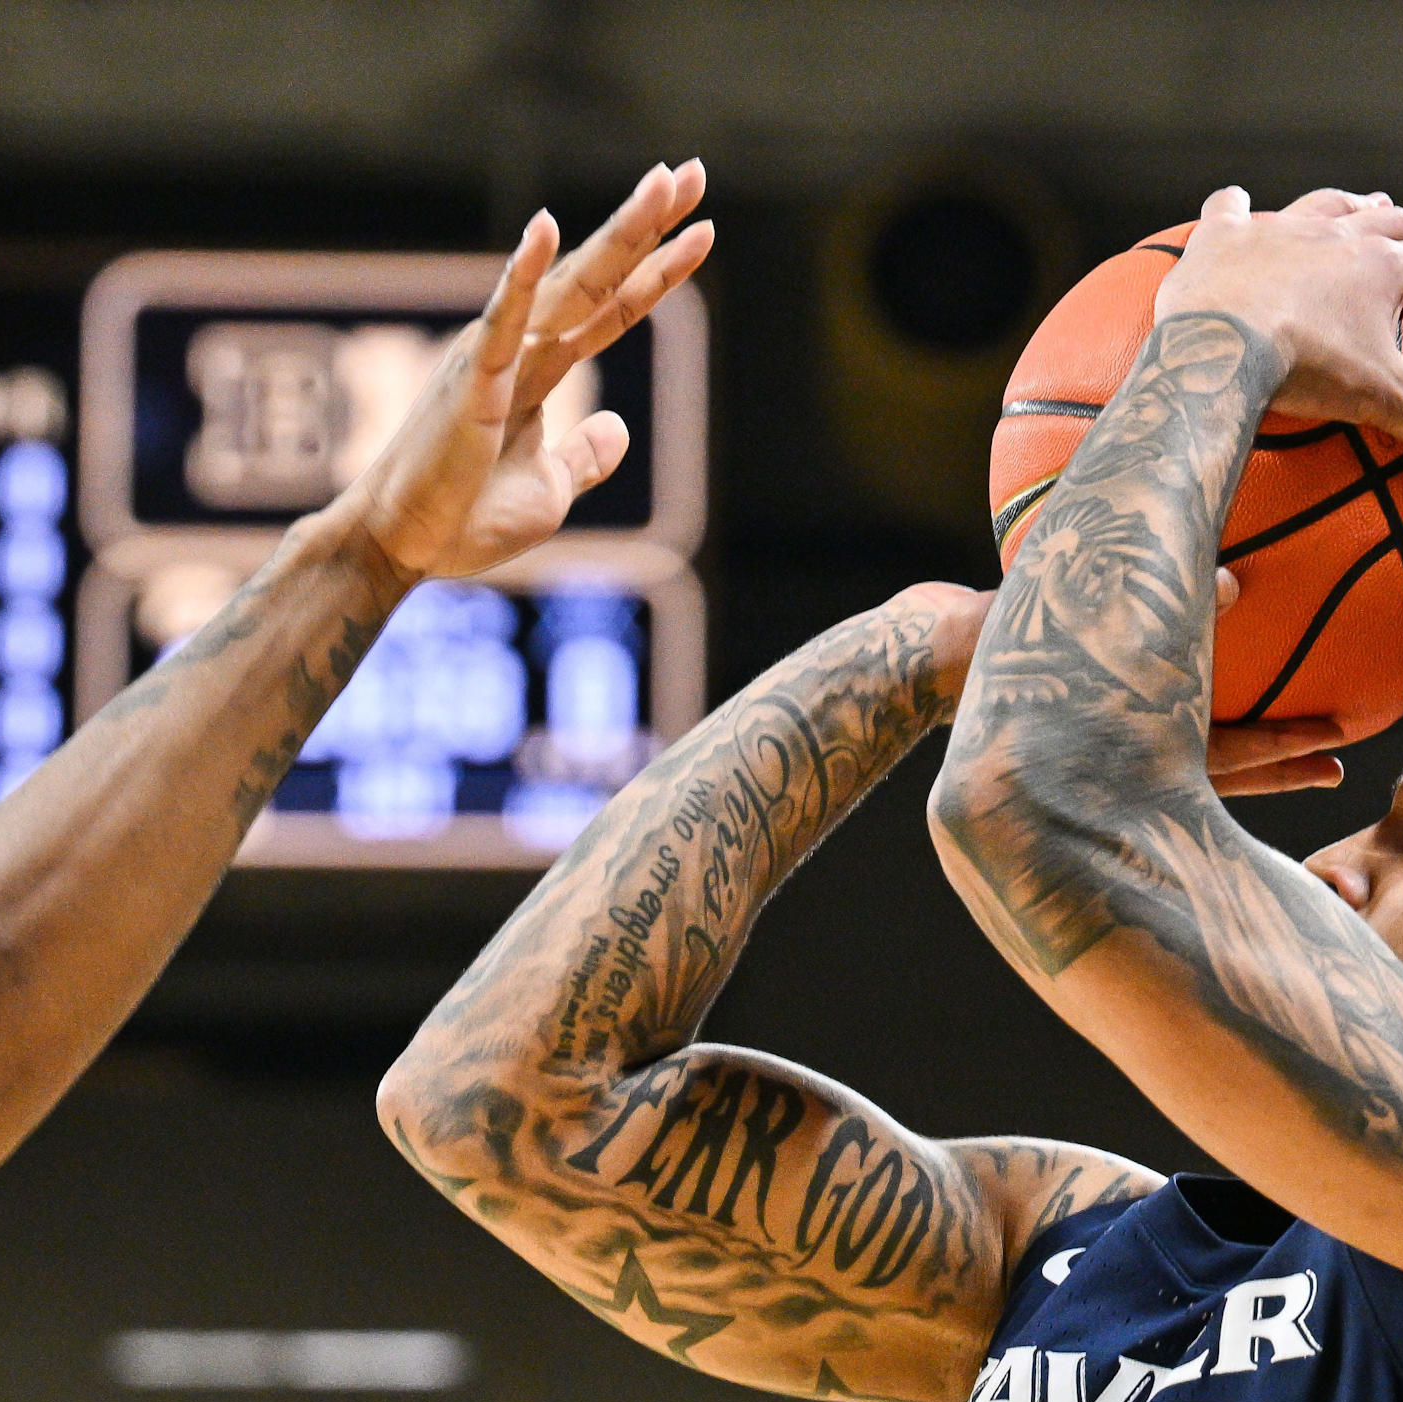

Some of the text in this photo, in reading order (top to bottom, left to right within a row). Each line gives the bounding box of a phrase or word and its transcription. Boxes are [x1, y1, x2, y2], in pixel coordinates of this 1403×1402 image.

[674, 777, 718, 841] who
[683, 694, 842, 972] Christ
[596, 844, 682, 1020] strengthens
[567, 1053, 935, 1289] FEAR GOD
